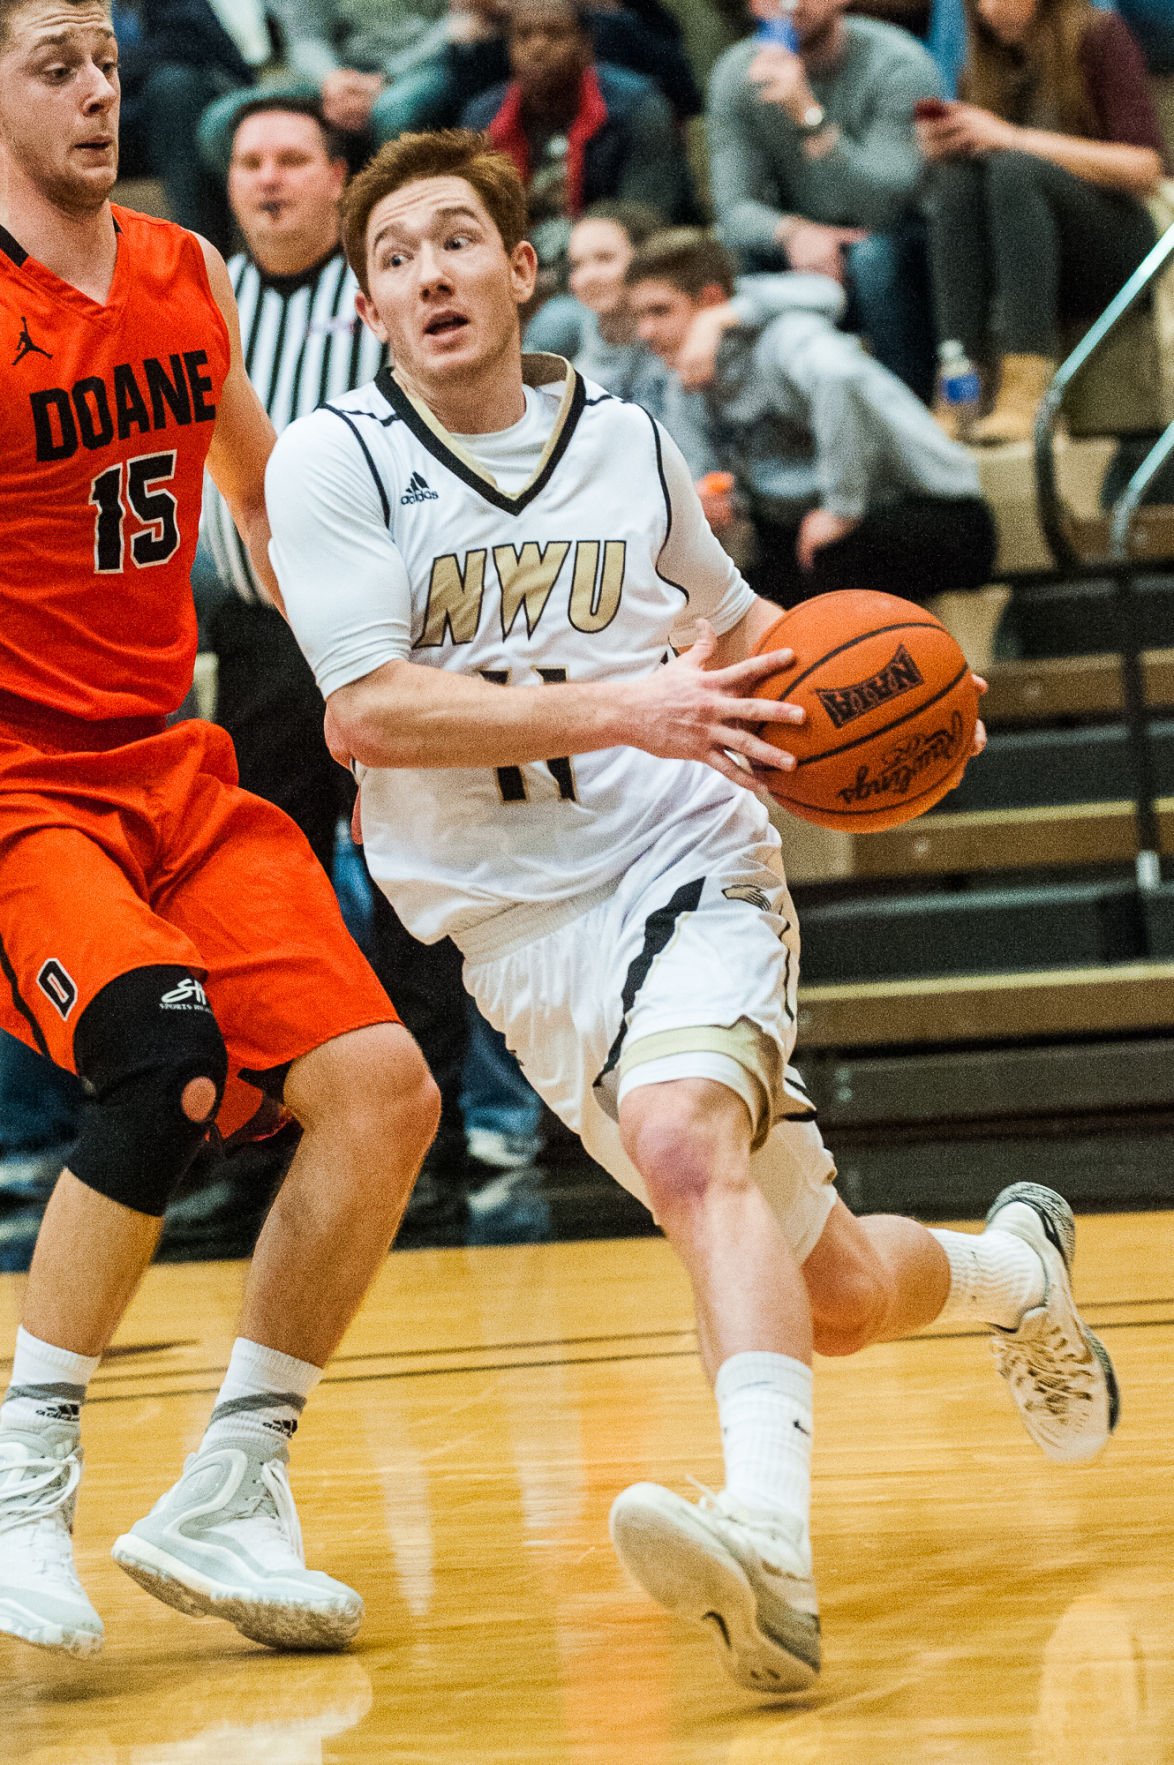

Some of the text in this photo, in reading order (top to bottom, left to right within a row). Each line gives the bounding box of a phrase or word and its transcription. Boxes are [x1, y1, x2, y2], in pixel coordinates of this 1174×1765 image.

[29, 349, 216, 462] DOANE
[88, 448, 181, 574] 15
[400, 488, 439, 505] adidas
[411, 540, 627, 650] NWU
[819, 650, 922, 726] NAIA
[837, 710, 964, 804] Rawlings
